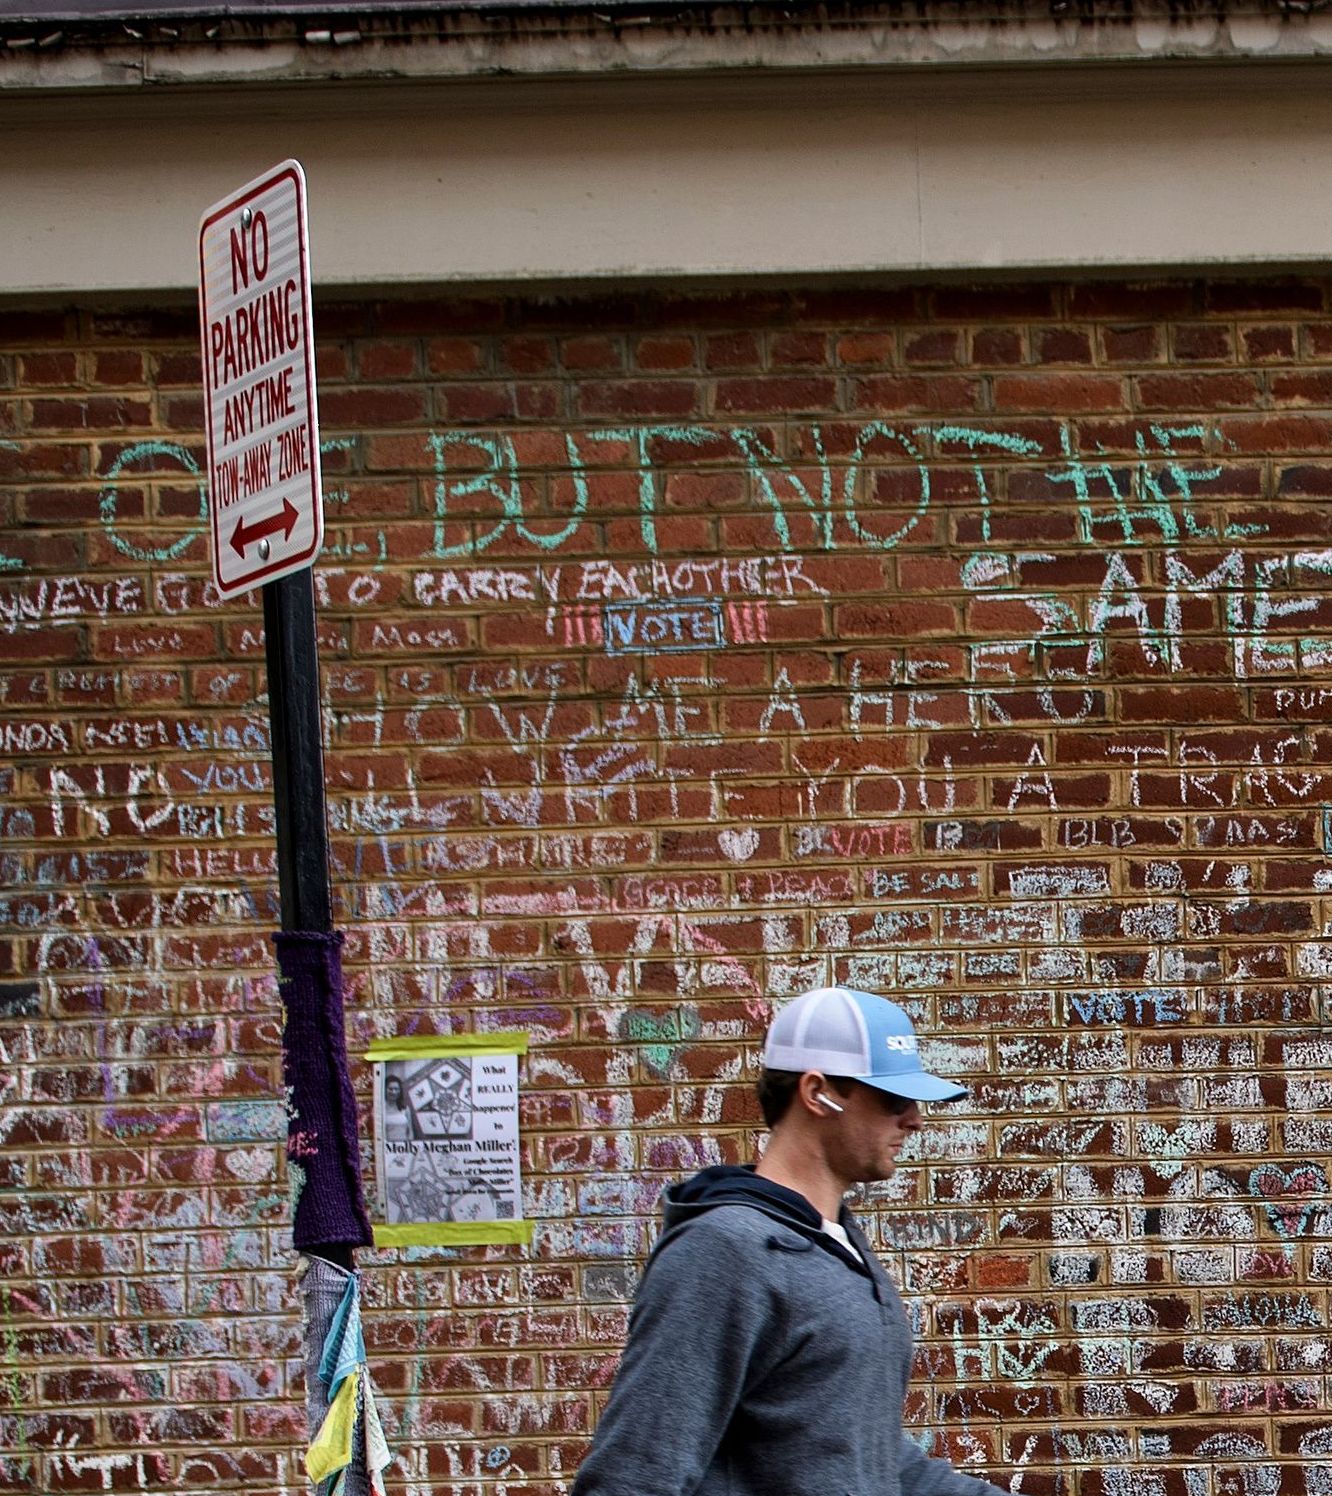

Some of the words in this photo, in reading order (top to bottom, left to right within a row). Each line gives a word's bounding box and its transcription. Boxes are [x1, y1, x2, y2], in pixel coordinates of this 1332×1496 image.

[230, 211, 269, 295] NO
[211, 280, 299, 389] PARKING
[223, 367, 296, 446] ANYTIME
[215, 447, 276, 510] TOW-AWAY
[278, 424, 310, 481] ZONE
[426, 425, 722, 562] BUT
[730, 420, 1043, 550] NOT
[609, 610, 715, 645] VOTE
[477, 1085, 514, 1094] REALLY
[482, 1066, 506, 1074] What
[385, 1140, 419, 1156] Molly
[424, 1140, 471, 1155] Meghan
